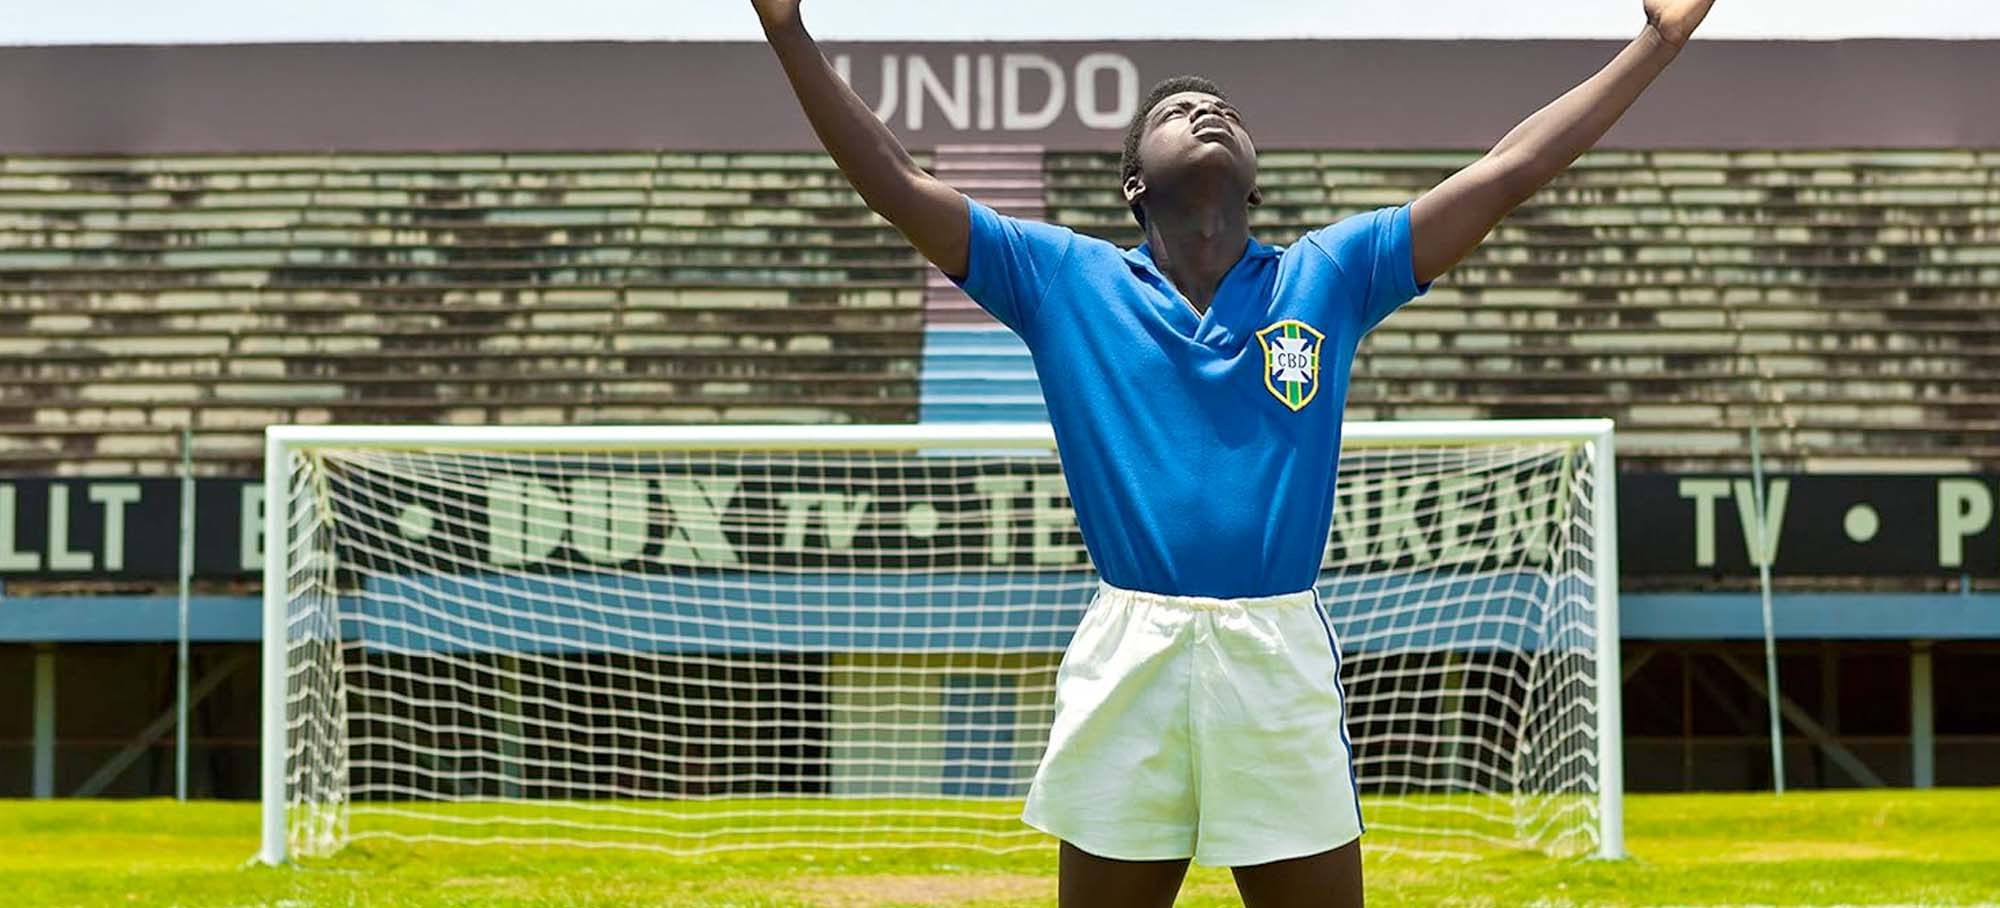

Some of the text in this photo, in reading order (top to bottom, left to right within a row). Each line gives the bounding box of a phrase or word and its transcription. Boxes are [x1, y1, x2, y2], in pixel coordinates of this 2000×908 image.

[1277, 352, 1308, 369] CBD
[486, 477, 742, 564] DUX
[779, 492, 869, 549] TV
[1679, 479, 1790, 567] TV
[1938, 479, 1994, 567] P
